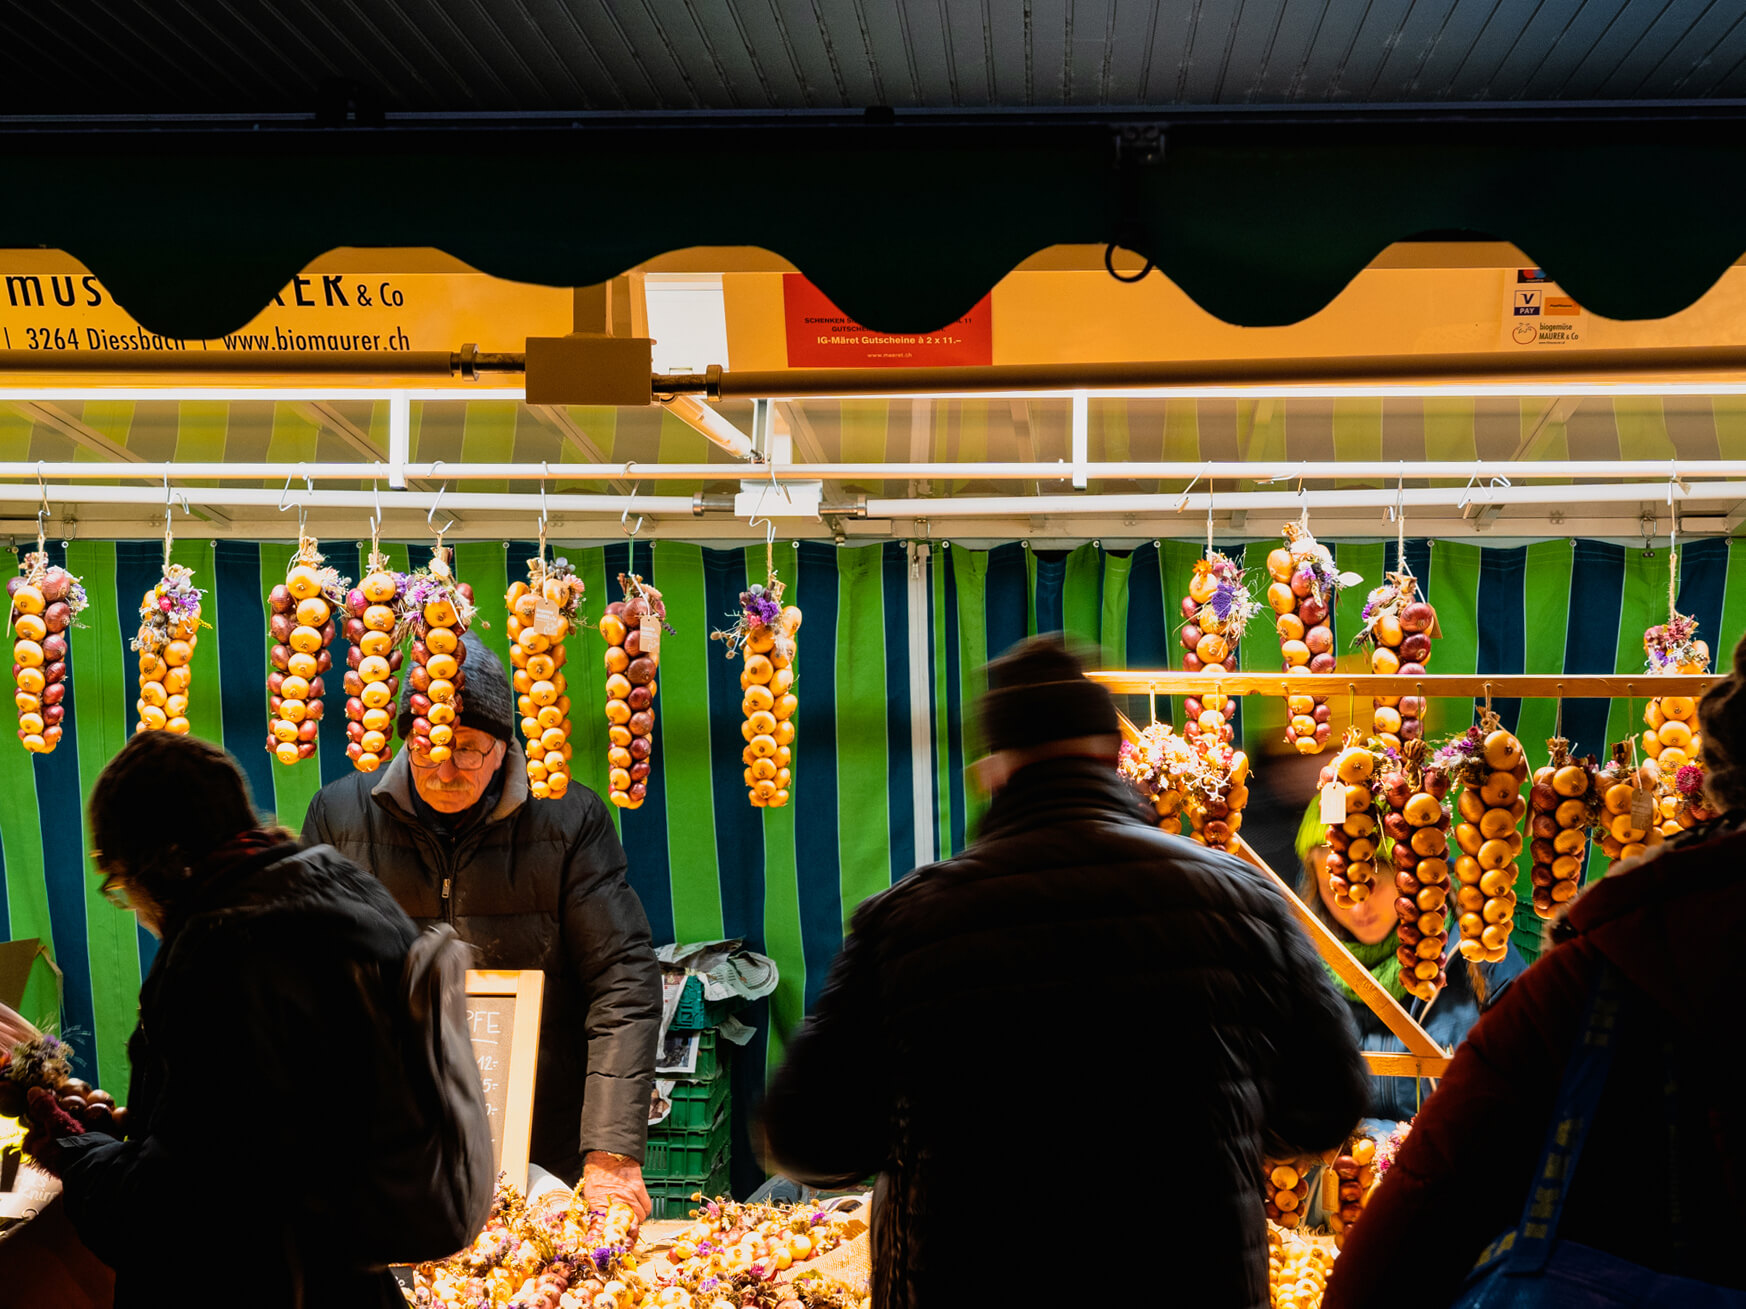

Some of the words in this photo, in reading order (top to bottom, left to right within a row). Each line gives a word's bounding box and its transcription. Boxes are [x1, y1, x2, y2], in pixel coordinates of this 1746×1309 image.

[267, 275, 349, 306] ER
[357, 284, 372, 306] &
[380, 282, 404, 307] Co
[1520, 293, 1534, 305] V
[26, 327, 79, 350] 3264
[222, 326, 410, 350] www.biomaurer.ch
[817, 336, 860, 344] IG-Märet
[861, 336, 916, 344] Gutscheine
[926, 336, 932, 344] 2
[1539, 332, 1565, 340] MAURER
[1571, 331, 1579, 340] Co
[1521, 1117, 1585, 1240] IKEA
